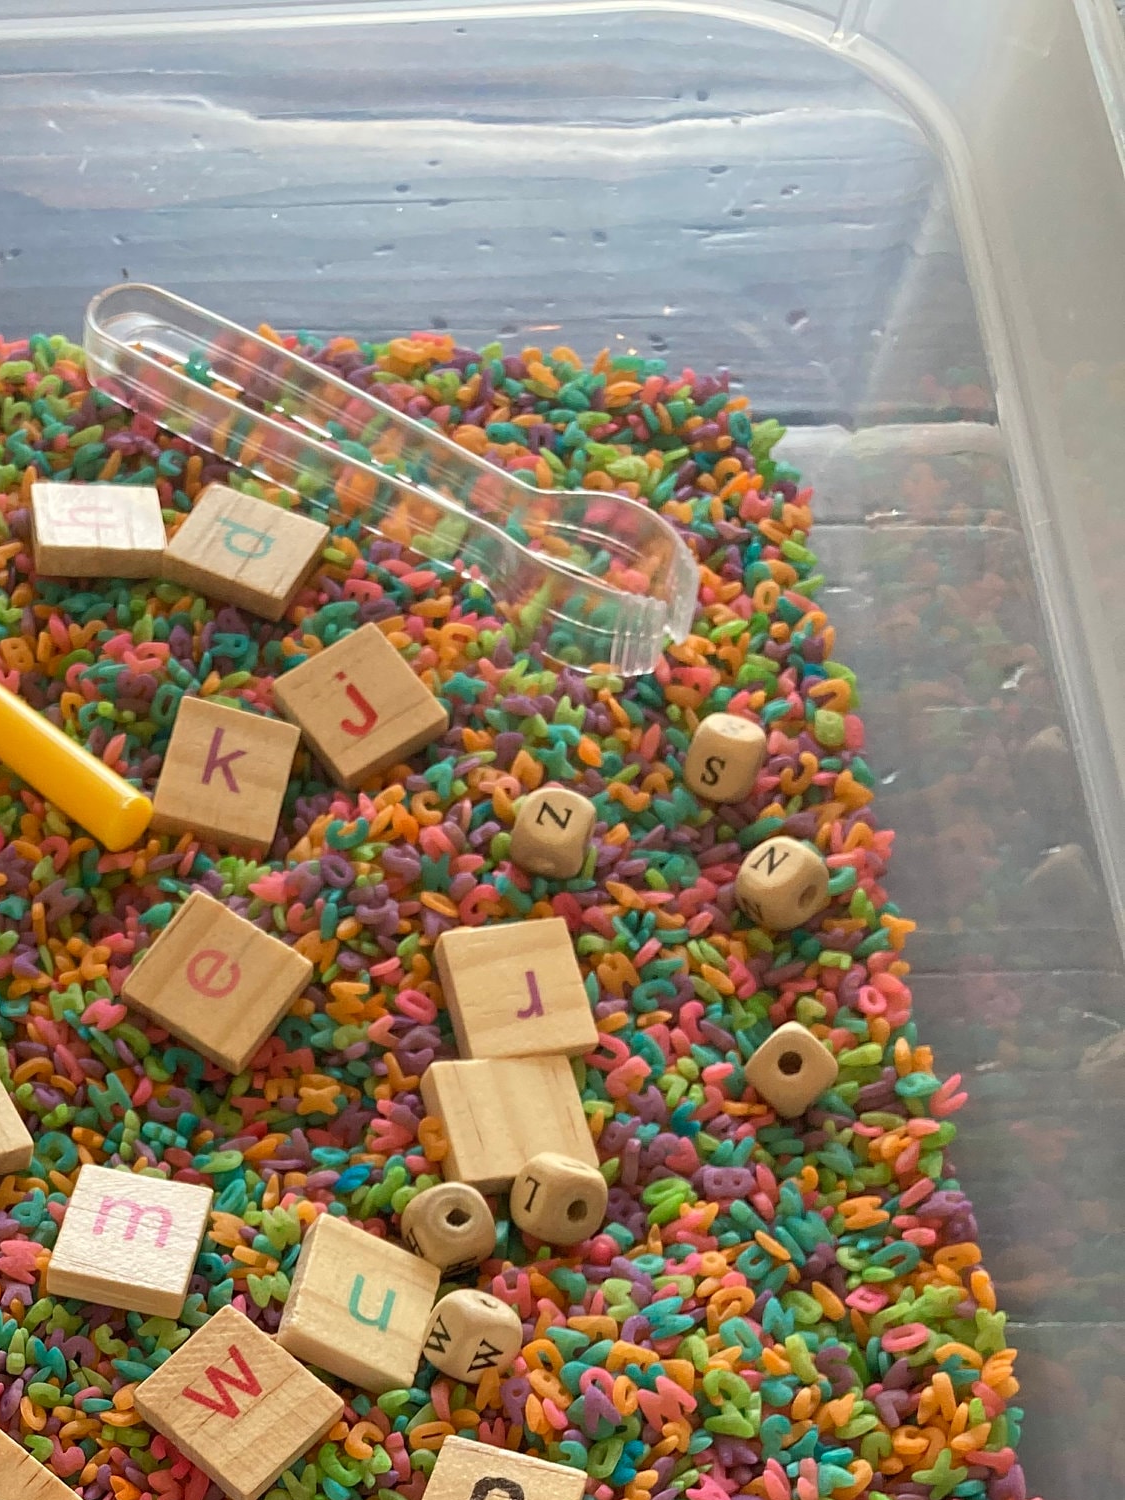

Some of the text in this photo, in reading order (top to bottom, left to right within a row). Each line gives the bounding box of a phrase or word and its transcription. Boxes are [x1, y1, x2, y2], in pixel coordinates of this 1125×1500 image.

[334, 671, 379, 738] j
[201, 726, 249, 794] k
[700, 755, 727, 786] S
[187, 949, 241, 998] e
[92, 1195, 174, 1249] m
[348, 1273, 396, 1333] u
